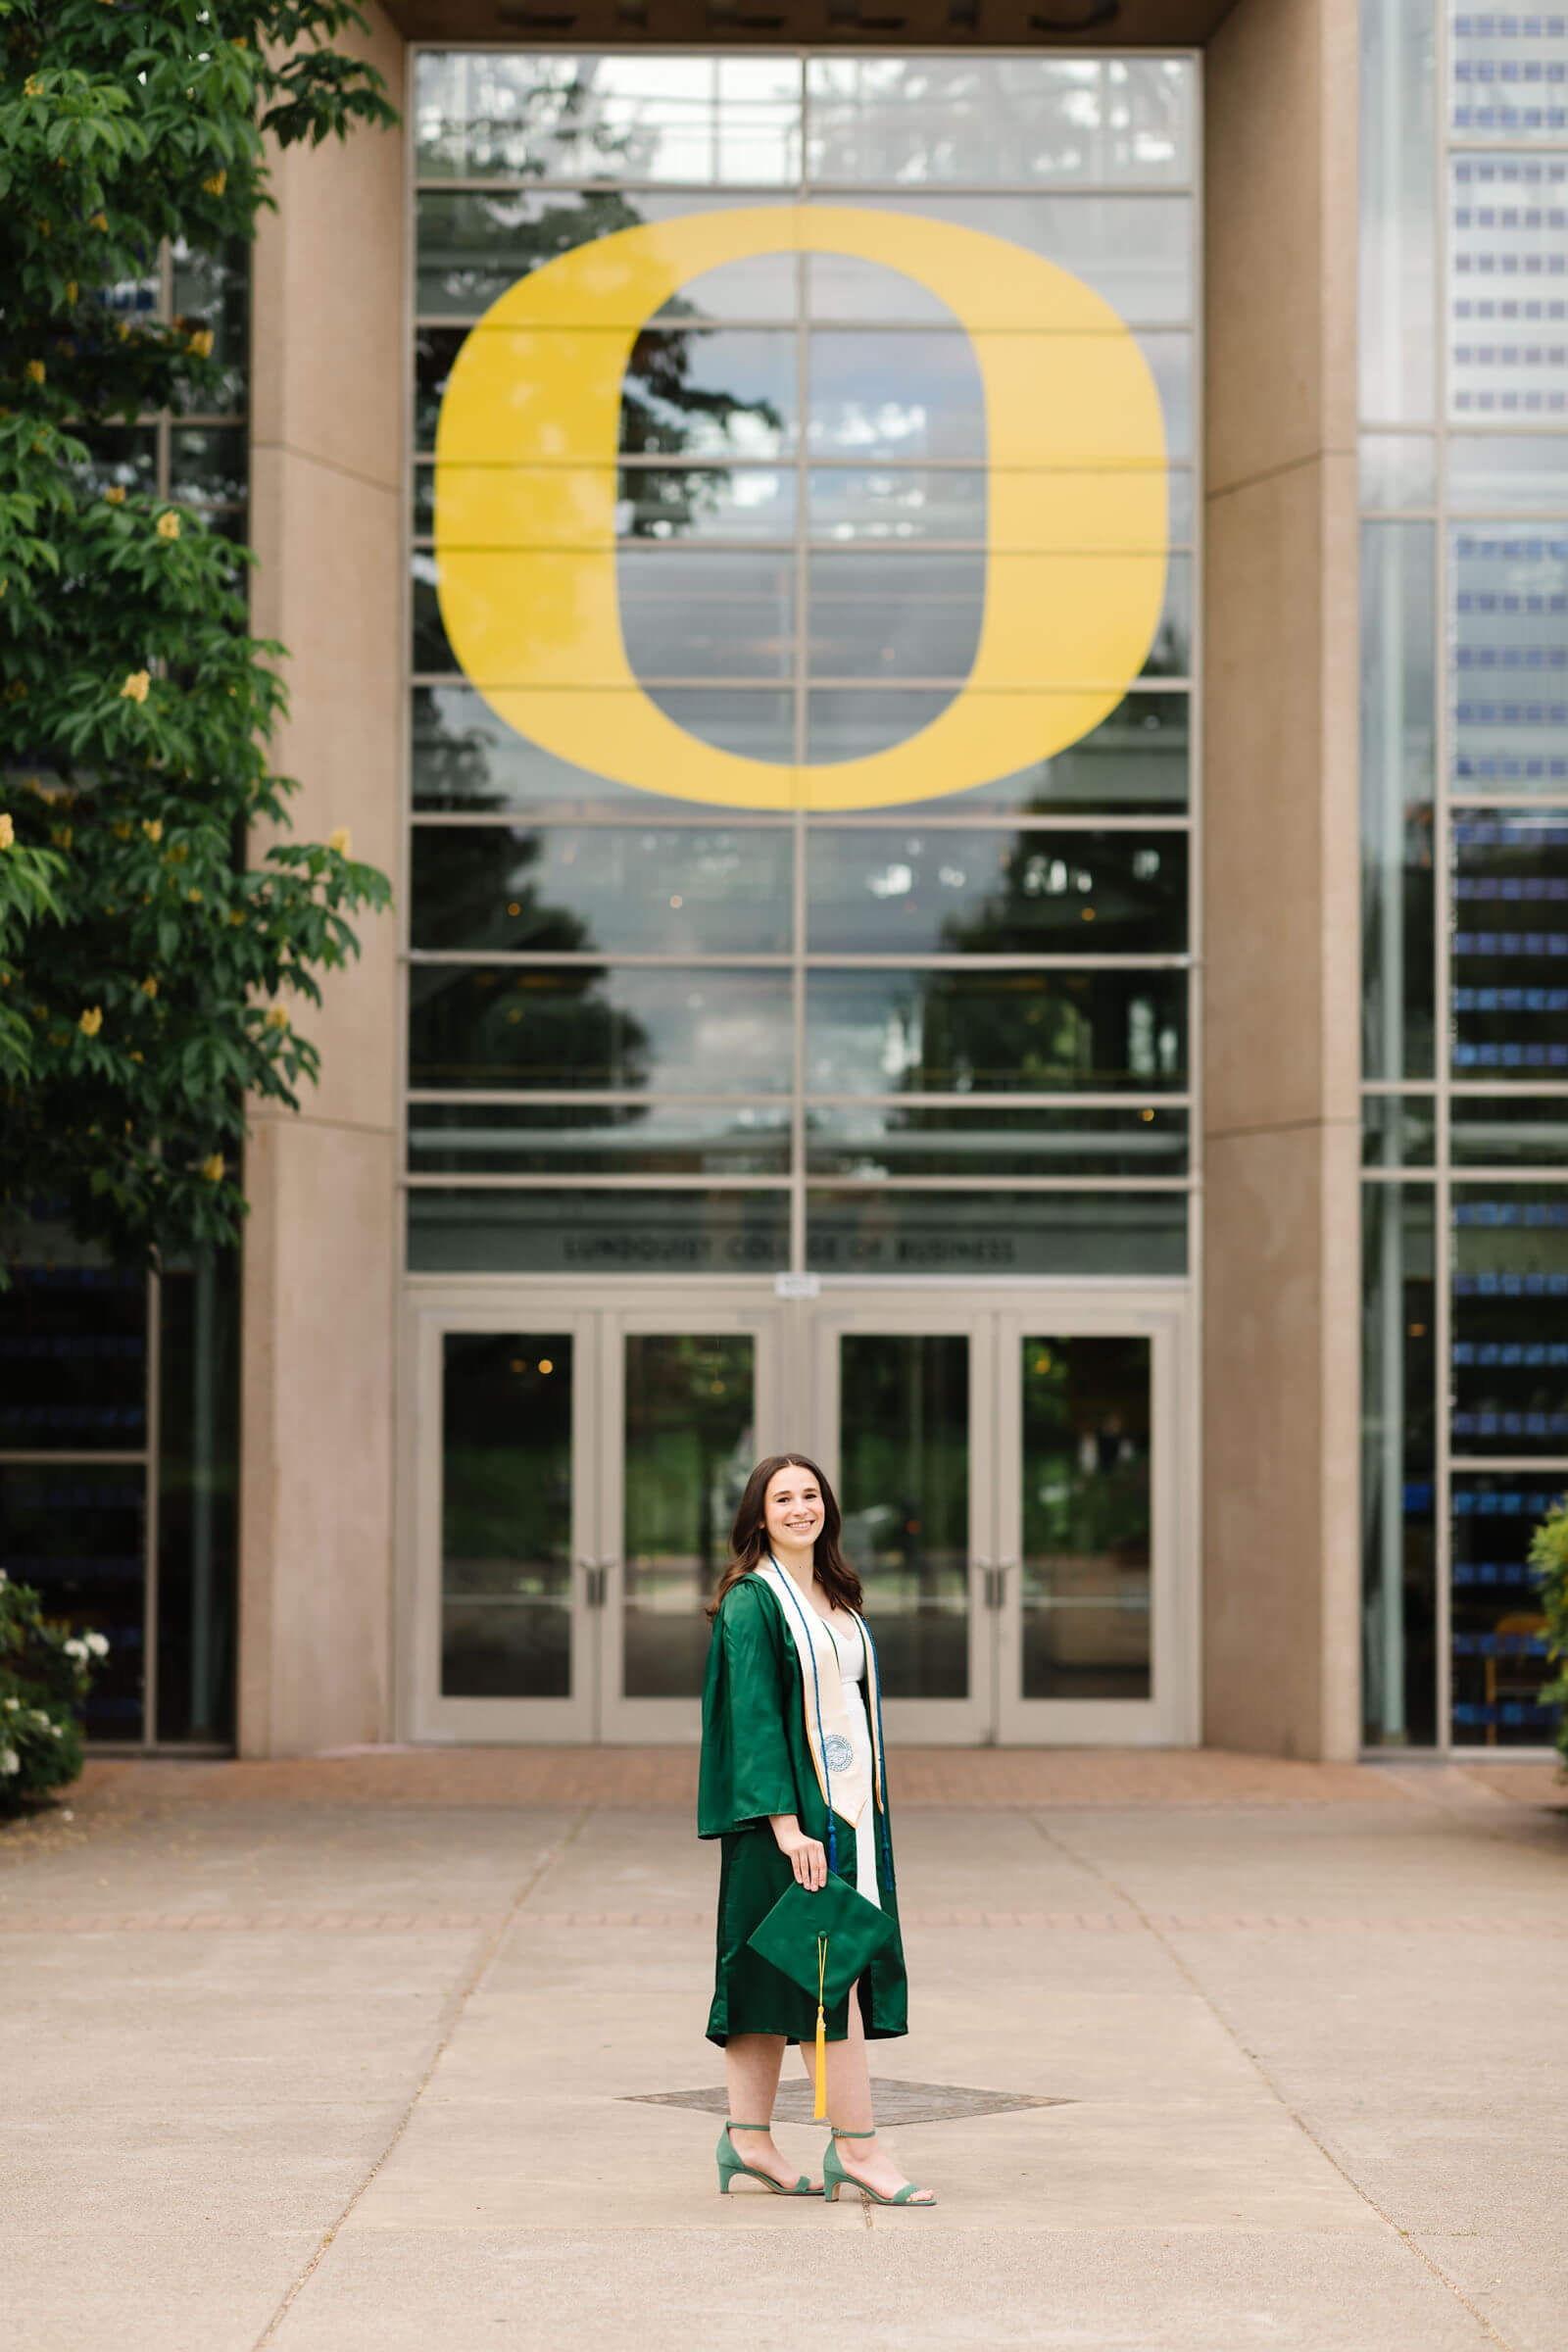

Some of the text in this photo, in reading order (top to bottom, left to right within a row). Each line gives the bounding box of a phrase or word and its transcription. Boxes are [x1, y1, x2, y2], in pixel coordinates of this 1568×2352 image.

[434, 205, 1169, 809] O
[725, 1236, 836, 1262] COLLGE
[897, 1237, 1015, 1263] BUSINESS
